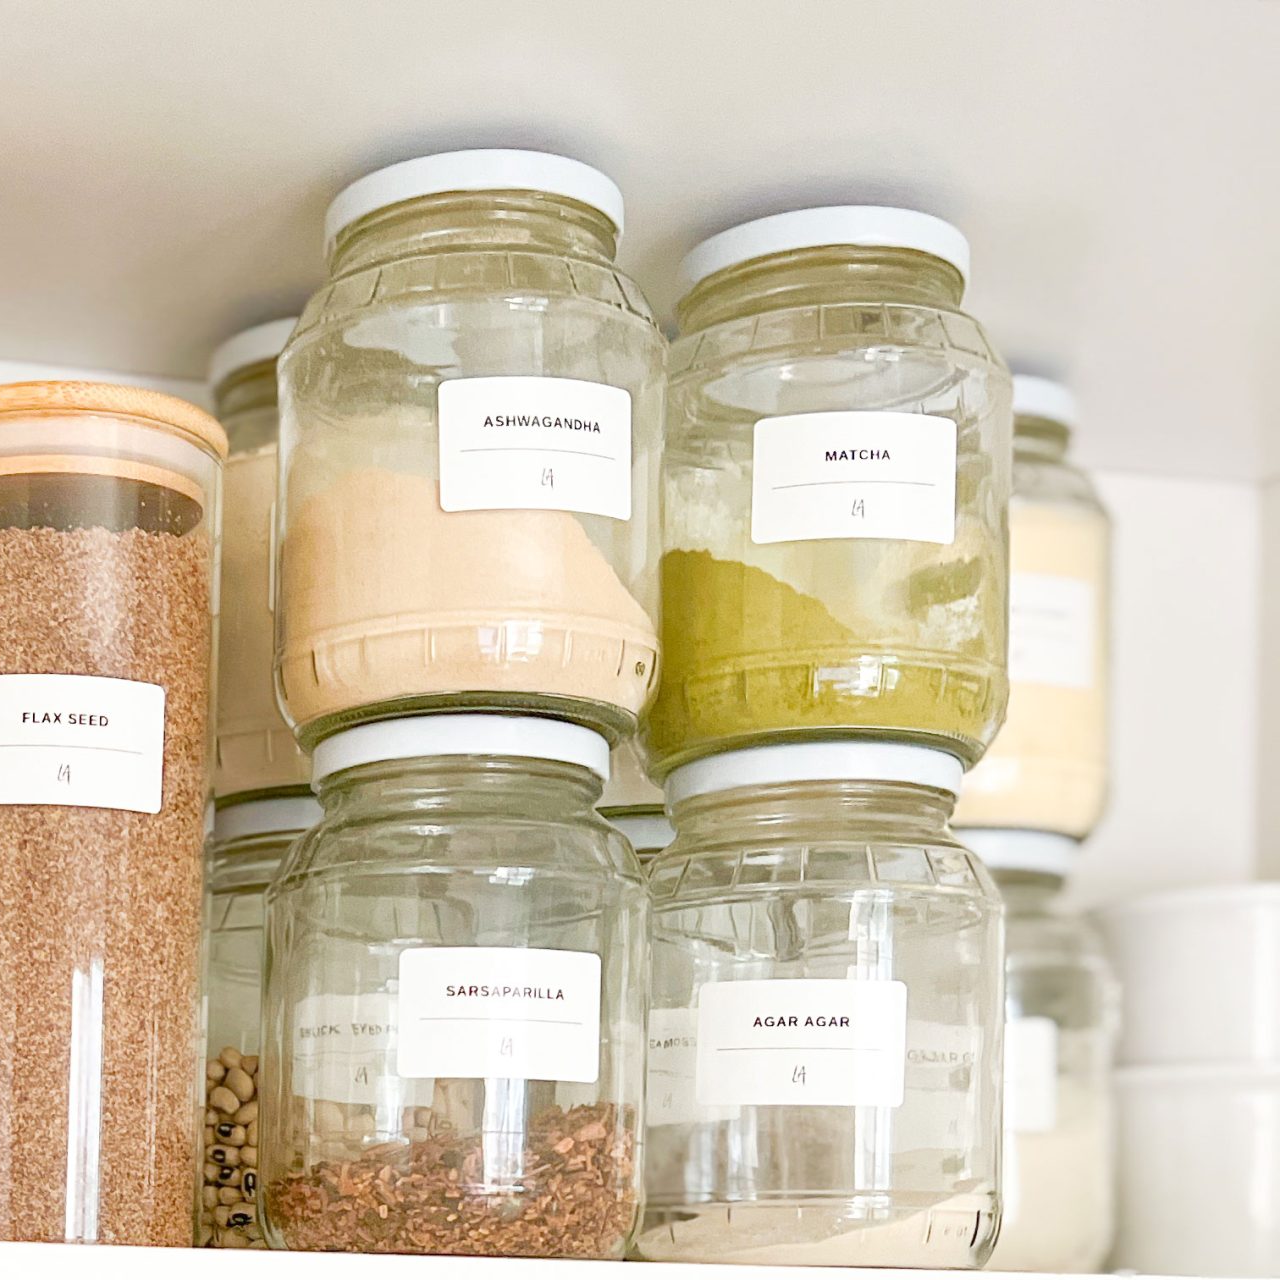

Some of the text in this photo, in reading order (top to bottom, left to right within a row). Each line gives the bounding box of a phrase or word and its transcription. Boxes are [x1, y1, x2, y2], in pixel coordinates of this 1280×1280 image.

[483, 413, 601, 435] ASHWAGANDHA
[824, 448, 891, 464] MATCHA
[21, 711, 110, 728] FLAX SEED
[445, 984, 565, 1002] SARSAPARILLA
[752, 1015, 850, 1028] AGAR AGAR
